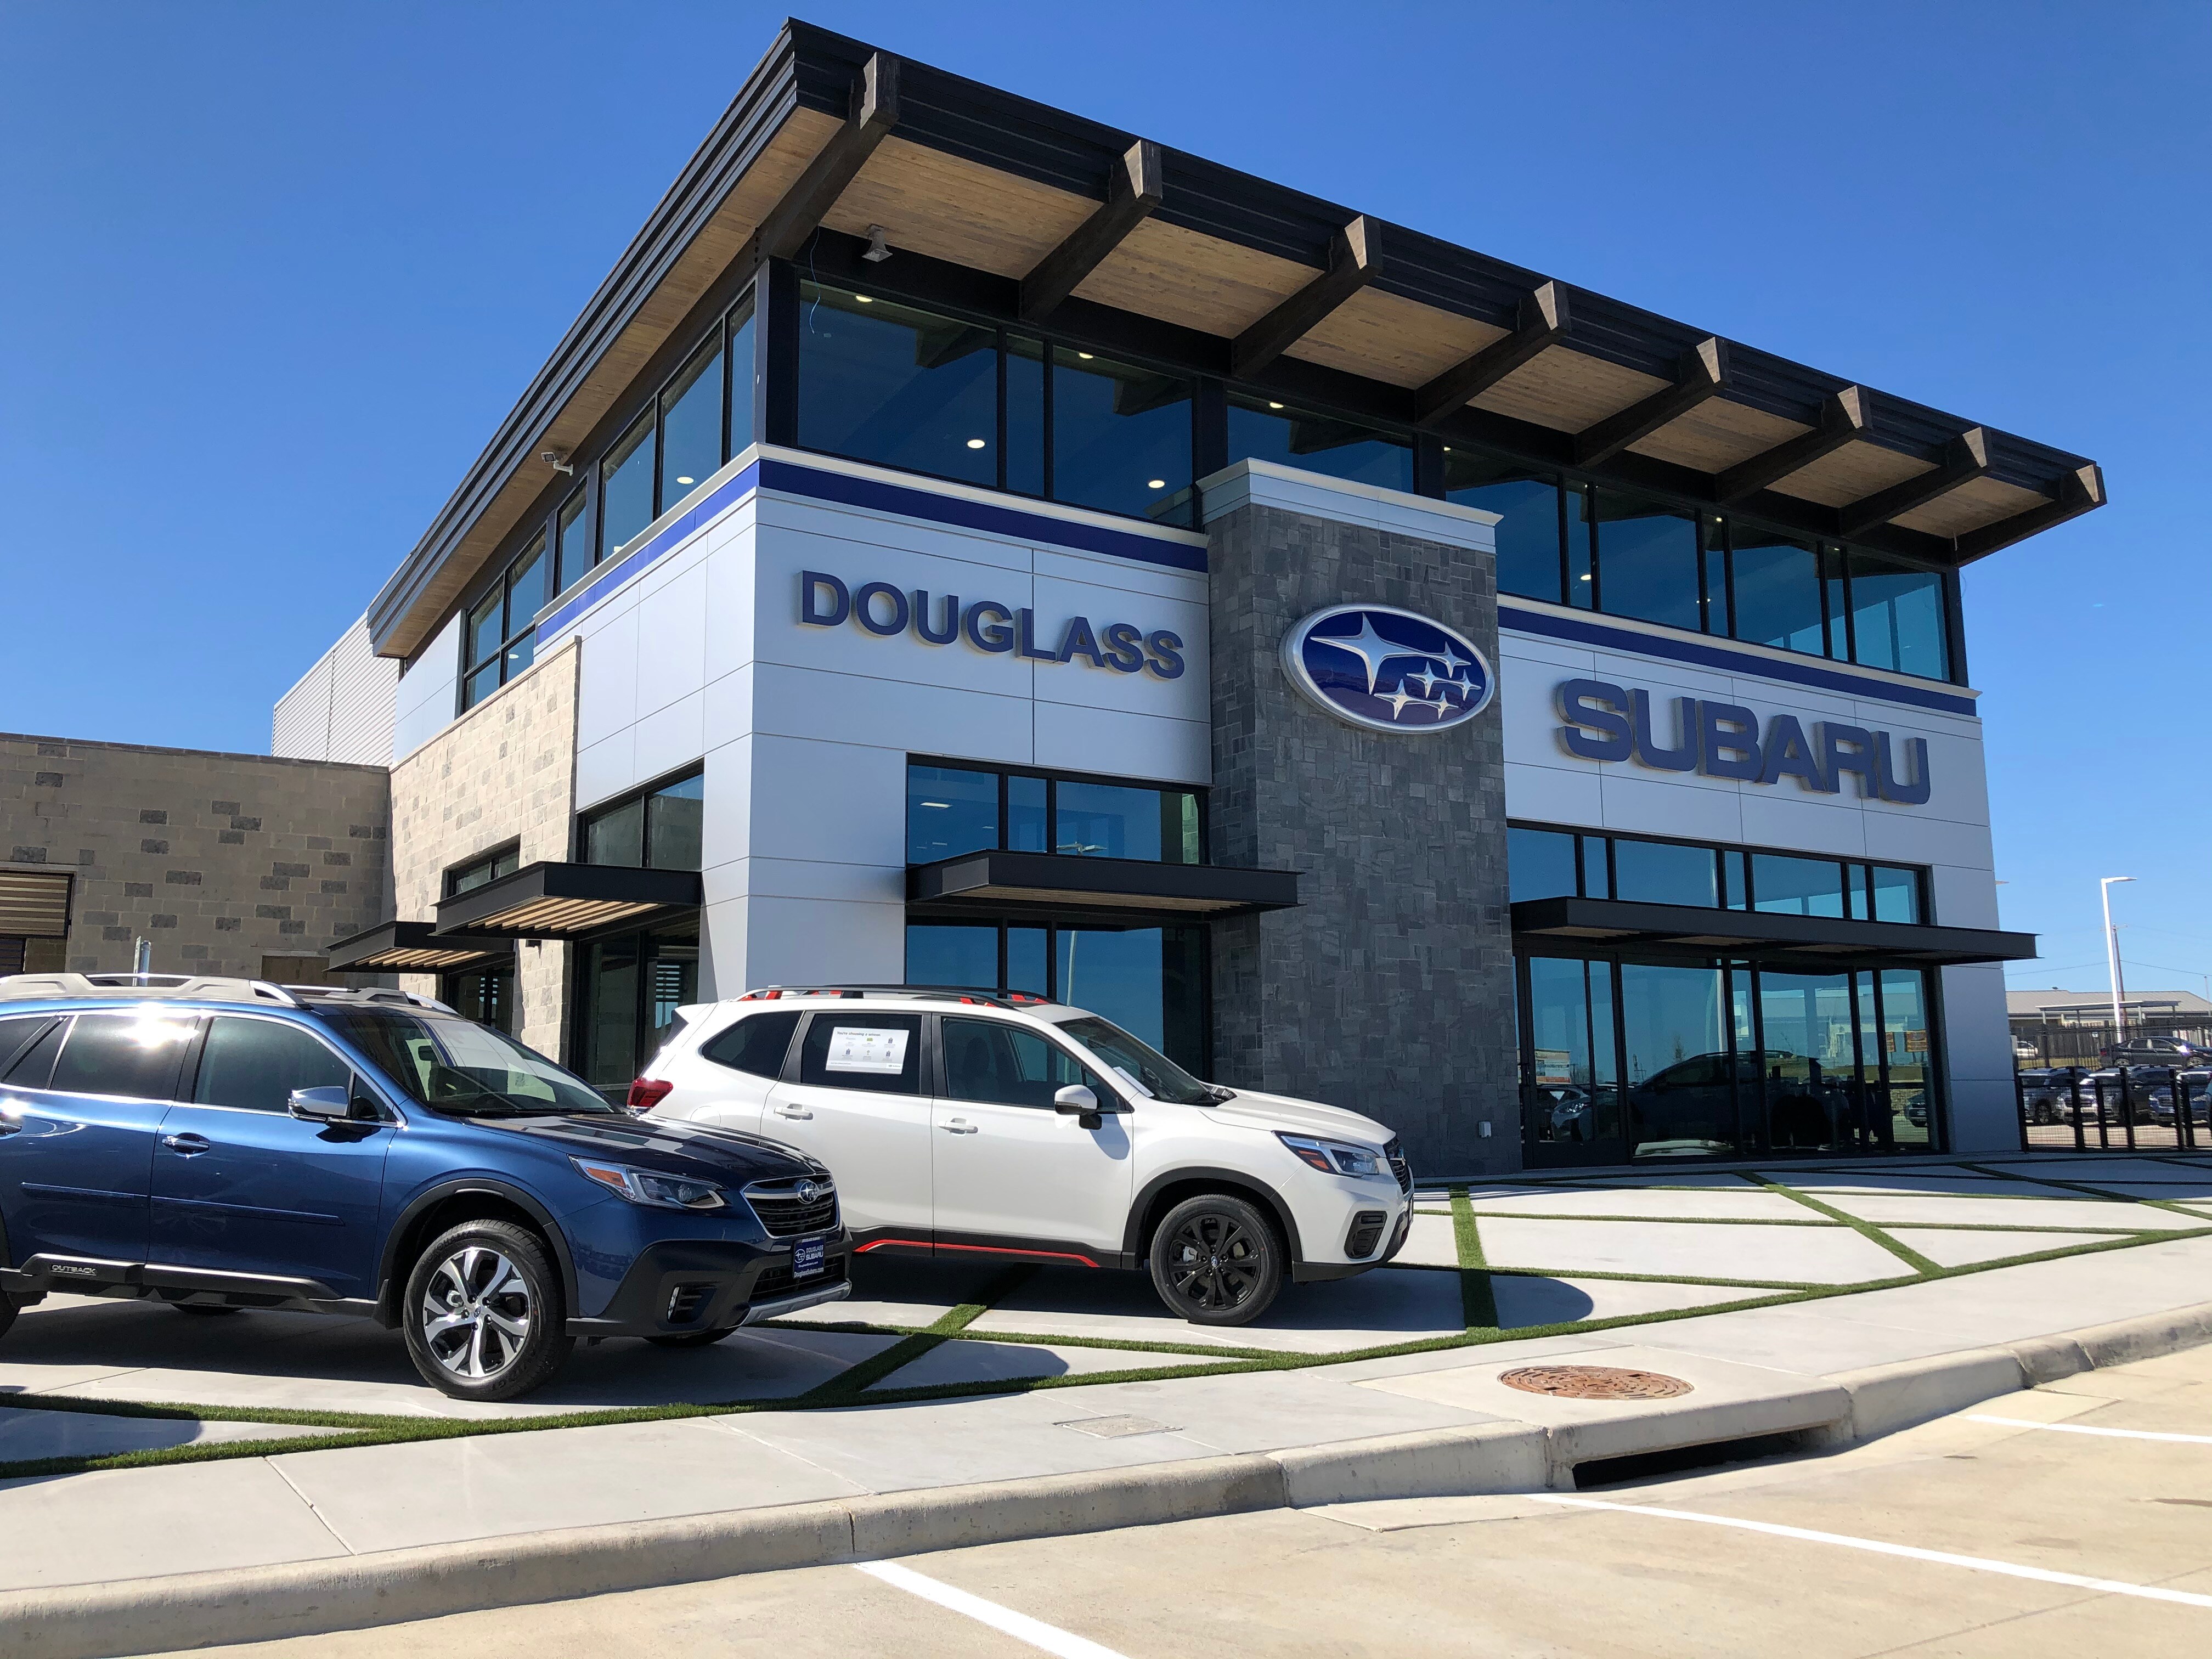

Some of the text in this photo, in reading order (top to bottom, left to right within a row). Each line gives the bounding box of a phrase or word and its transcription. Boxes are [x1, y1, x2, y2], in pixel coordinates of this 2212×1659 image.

[798, 569, 1186, 680] DOUGLASS
[1556, 678, 1931, 805] SUBARU
[52, 1264, 97, 1274] OUTBACK
[805, 1251, 824, 1261] SUBARU
